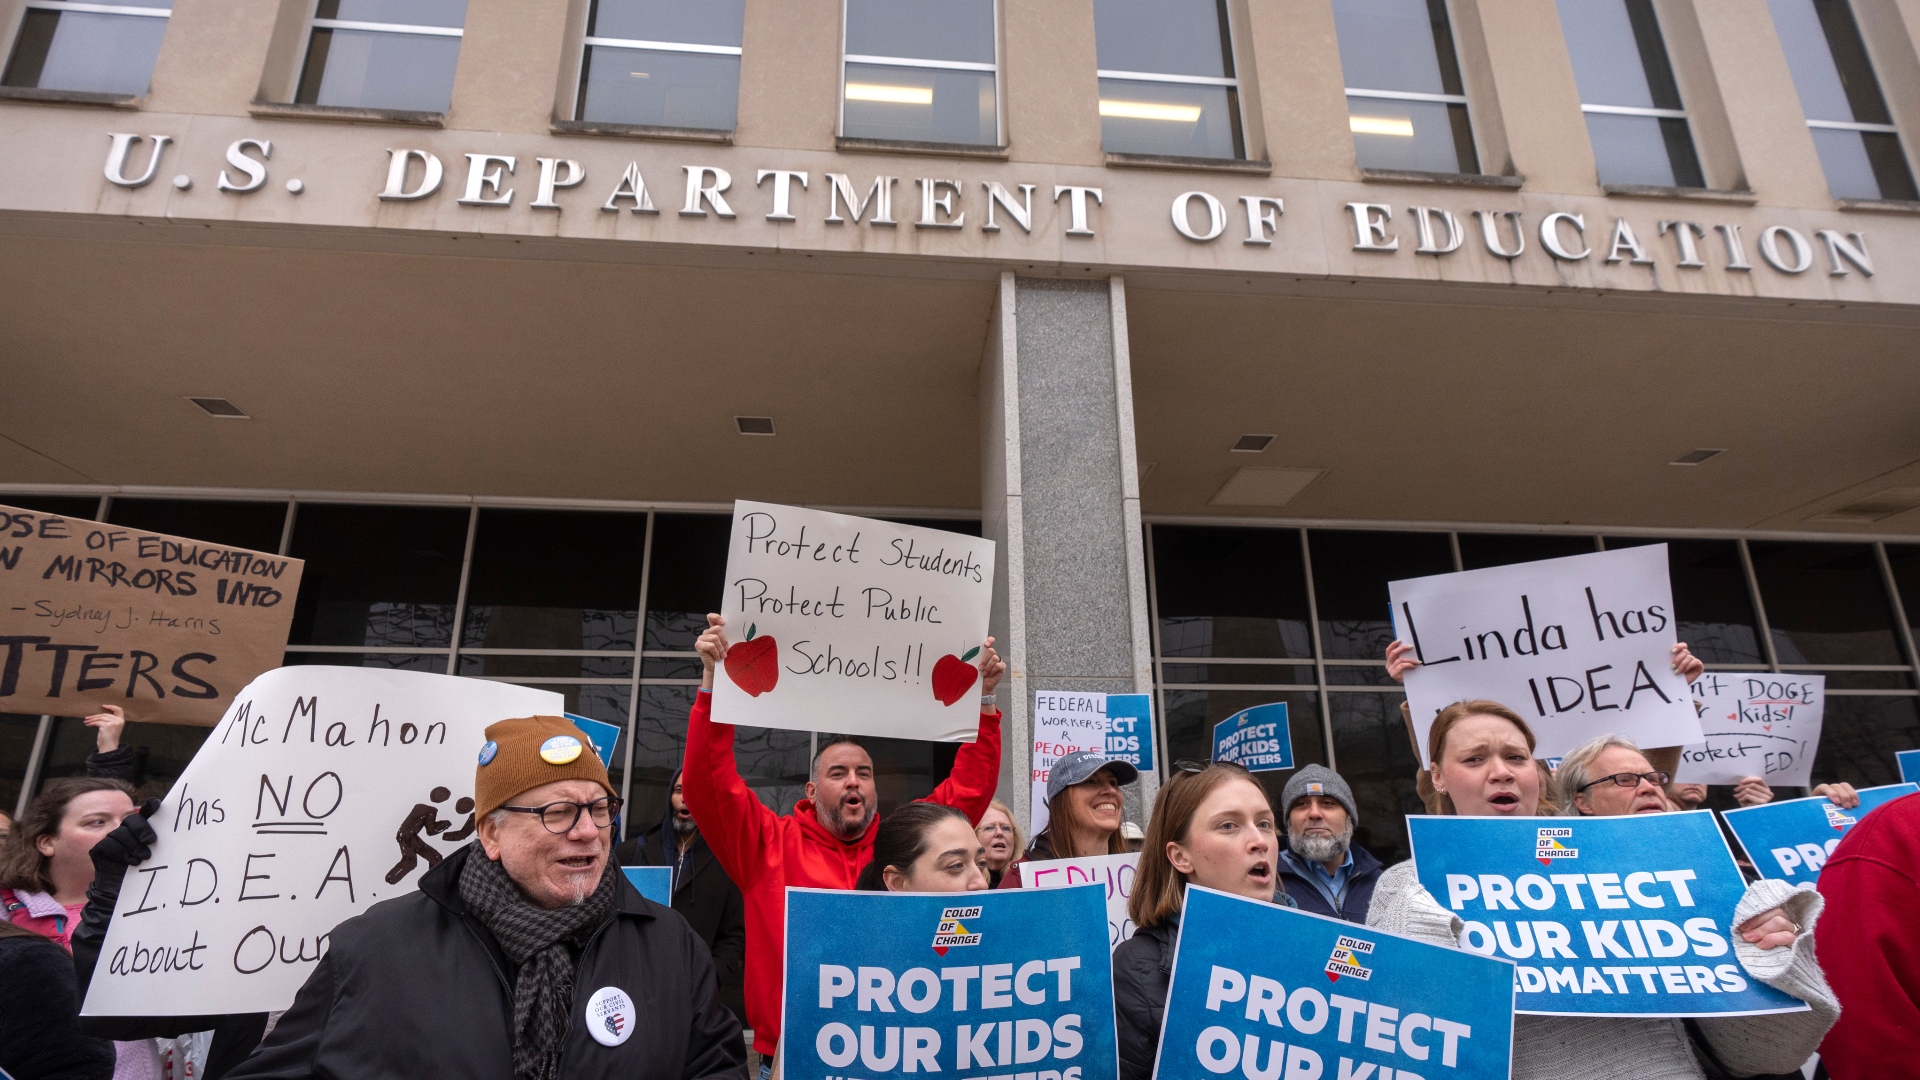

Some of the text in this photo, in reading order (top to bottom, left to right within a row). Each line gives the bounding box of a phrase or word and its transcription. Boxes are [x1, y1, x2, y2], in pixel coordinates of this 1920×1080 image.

[378, 147, 1102, 238] DEPARTMENT
[1170, 190, 1284, 246] OF
[1345, 202, 1876, 278] EDUCATION
[85, 531, 131, 551] OF
[138, 536, 289, 580] EDUCATION
[742, 512, 982, 583] Protect Students
[42, 555, 198, 597] MIRRORS
[216, 578, 283, 608] INTO
[35, 600, 111, 634] Sydney
[116, 606, 139, 630] J.
[150, 610, 221, 635] Harris
[734, 578, 942, 624] Protect Public
[1402, 586, 1668, 666] Linda has
[786, 640, 923, 685] Schools!!
[1037, 696, 1107, 714] FEDERAL
[1743, 678, 1814, 704] DOGE
[1041, 716, 1103, 730] WORKERS
[1061, 730, 1072, 742] R
[1218, 722, 1277, 754] PROTECT
[1234, 753, 1282, 766] ATTERS
[1241, 738, 1280, 756] KIDS
[174, 771, 343, 833] has NO
[1538, 839, 1552, 847] OF
[1539, 829, 1570, 837] COLOR
[1446, 869, 1697, 911] PROTECT
[940, 922, 956, 932] OF
[944, 908, 980, 918] COLOR
[109, 930, 207, 976] about
[935, 935, 979, 945] CHANGE
[1333, 950, 1349, 959] OF
[1339, 937, 1372, 952] COLOR
[1460, 917, 1729, 959] OUR KIDS
[818, 956, 1081, 1014] PROTECT
[1328, 962, 1369, 978] CHANGE
[1205, 965, 1471, 1068] PROTECT
[816, 1013, 1084, 1073] OUR KIDS
